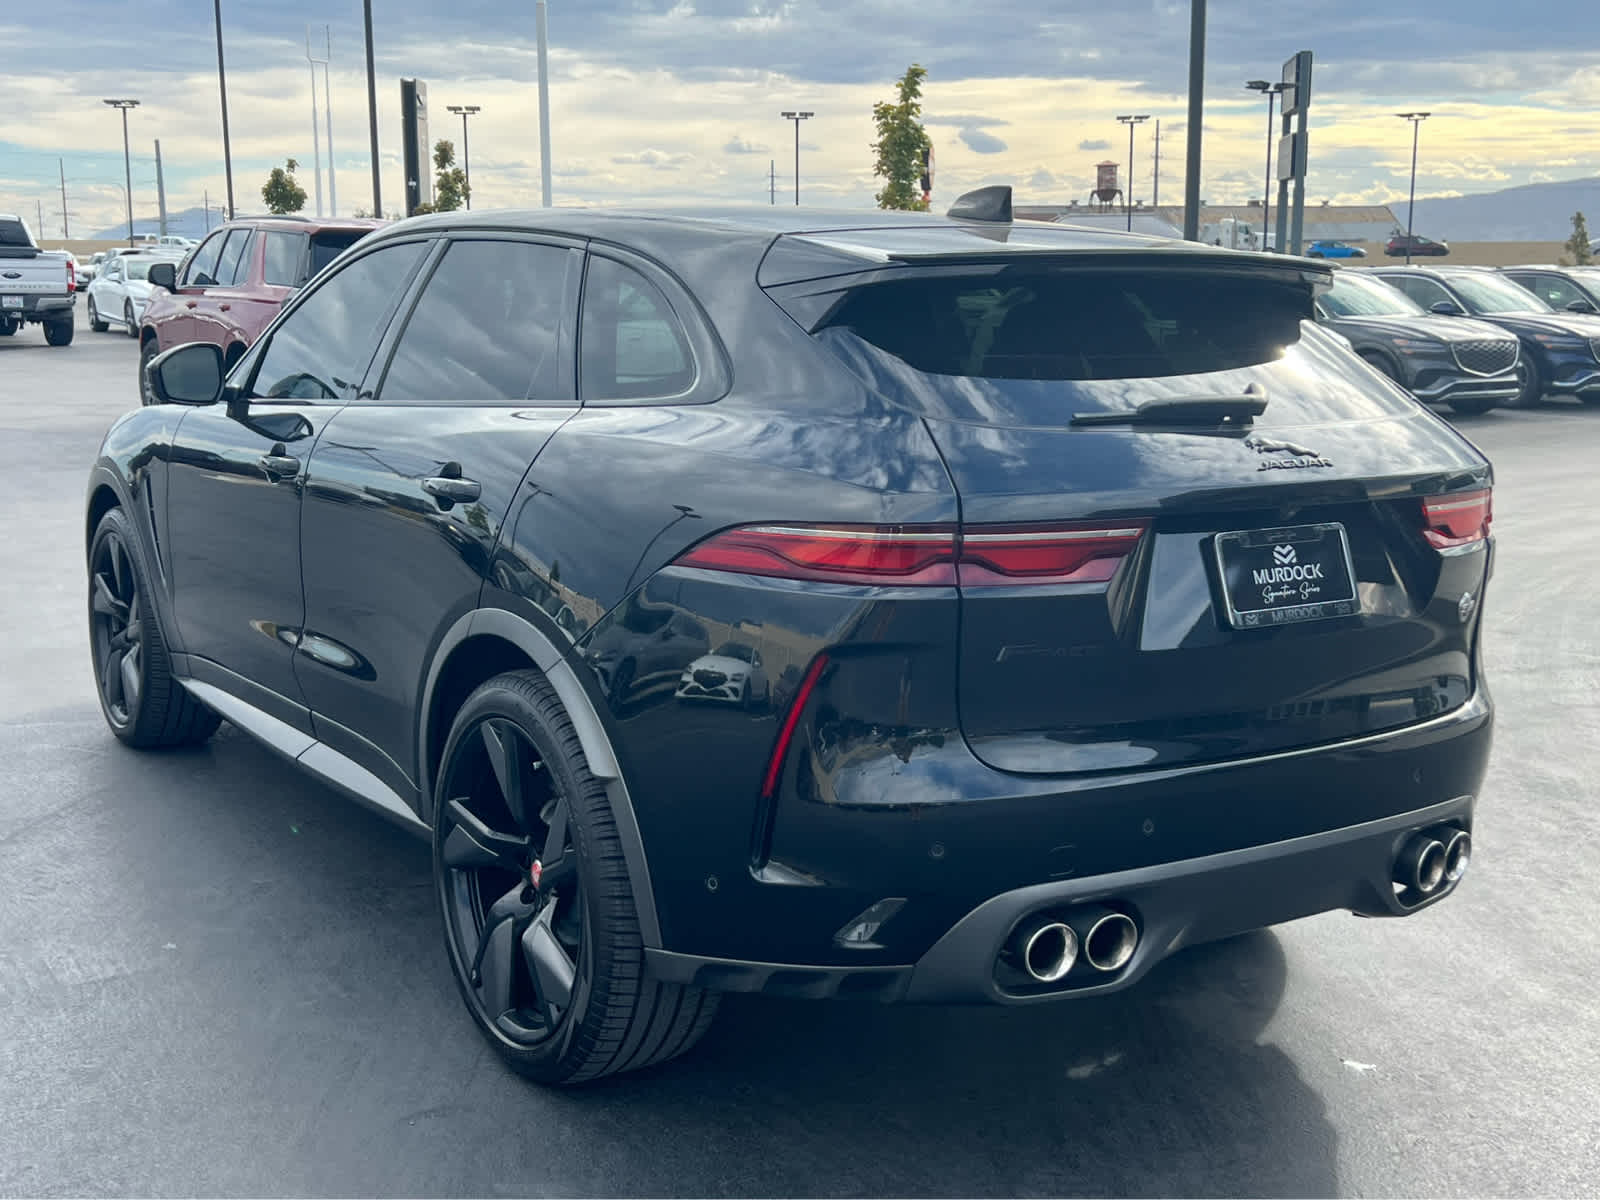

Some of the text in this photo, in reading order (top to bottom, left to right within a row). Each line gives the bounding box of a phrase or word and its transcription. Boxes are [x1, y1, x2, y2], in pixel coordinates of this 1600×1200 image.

[1257, 457, 1334, 472] JAGUAR
[1252, 563, 1324, 585] MURDOCK
[1271, 606, 1325, 624] MURDOCK
